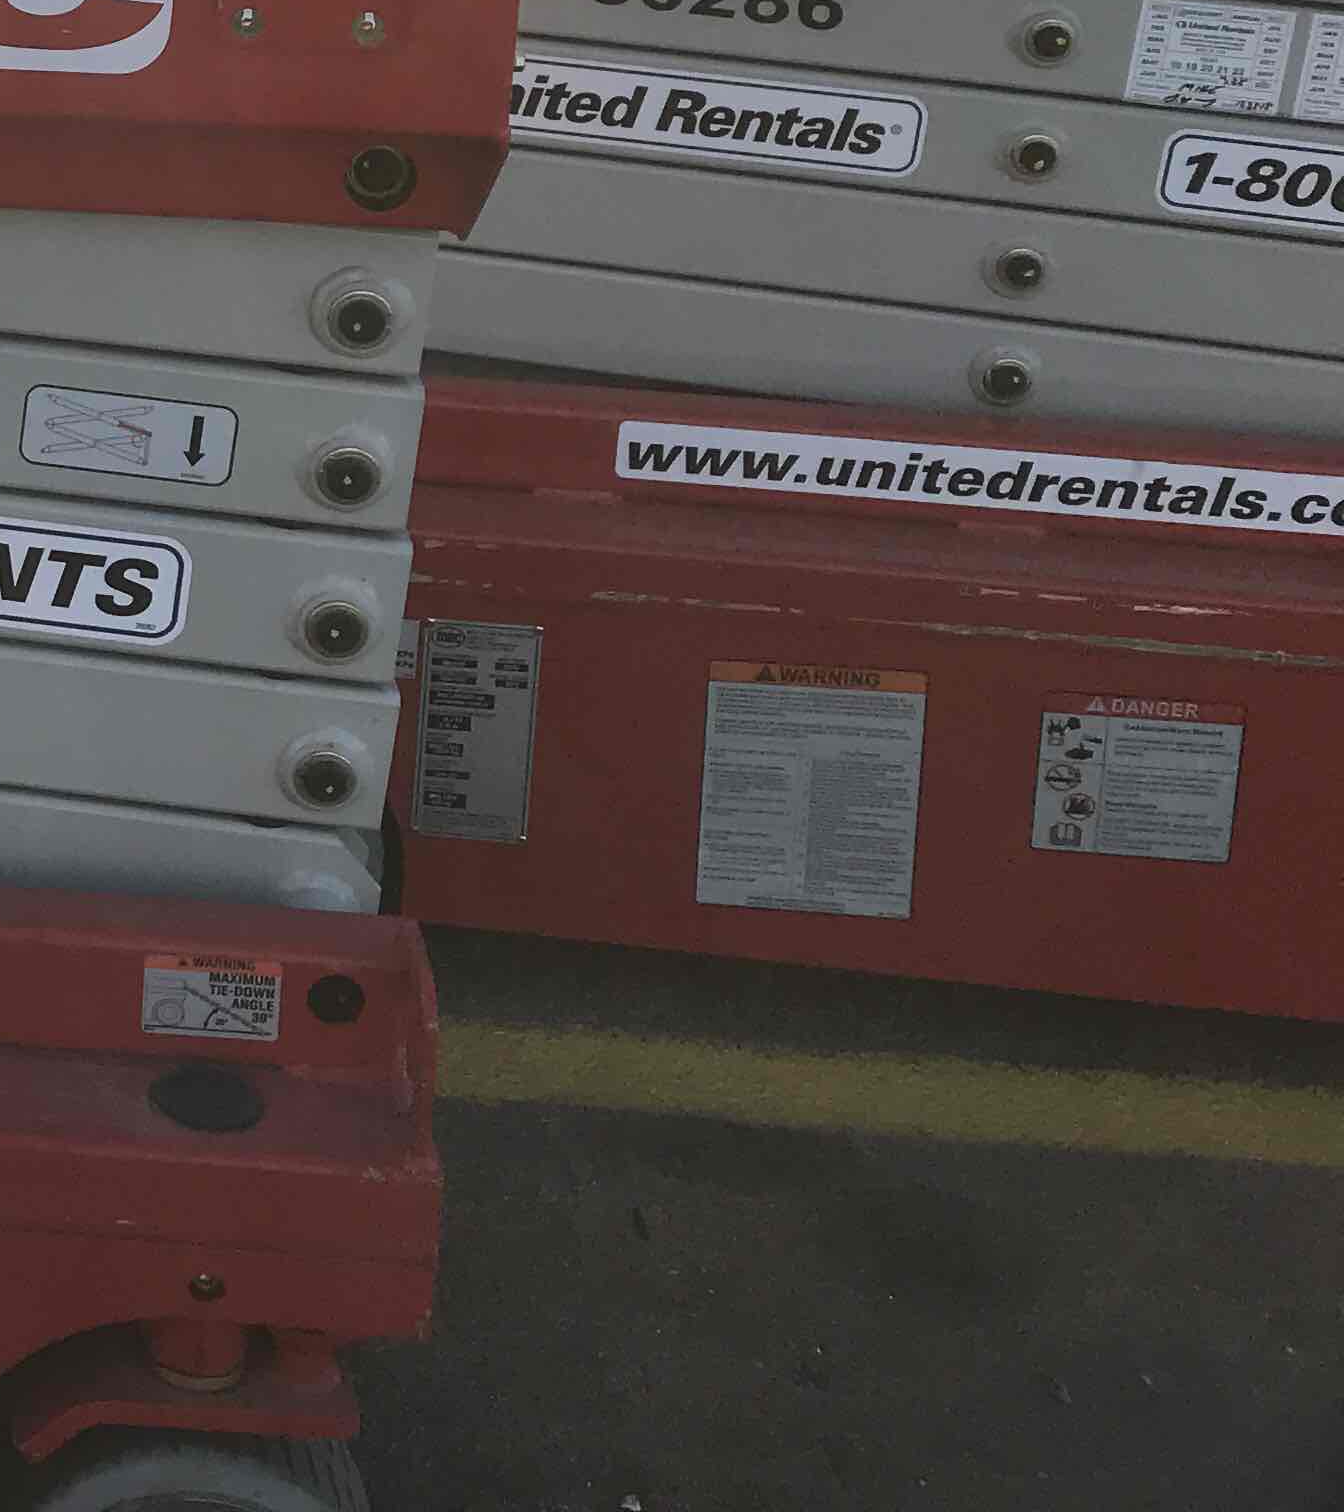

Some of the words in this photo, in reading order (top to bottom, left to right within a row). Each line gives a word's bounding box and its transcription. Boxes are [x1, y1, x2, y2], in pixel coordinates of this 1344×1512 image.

[655, 87, 886, 155] Rentals
[1184, 151, 1344, 214] 1-80
[780, 667, 881, 687] WARNING
[1112, 697, 1200, 719] DANGER
[192, 956, 256, 971] WARNING
[208, 971, 276, 986] MAXIMUM
[210, 984, 275, 999] TIE-DOWN
[231, 998, 274, 1012] ANGLE
